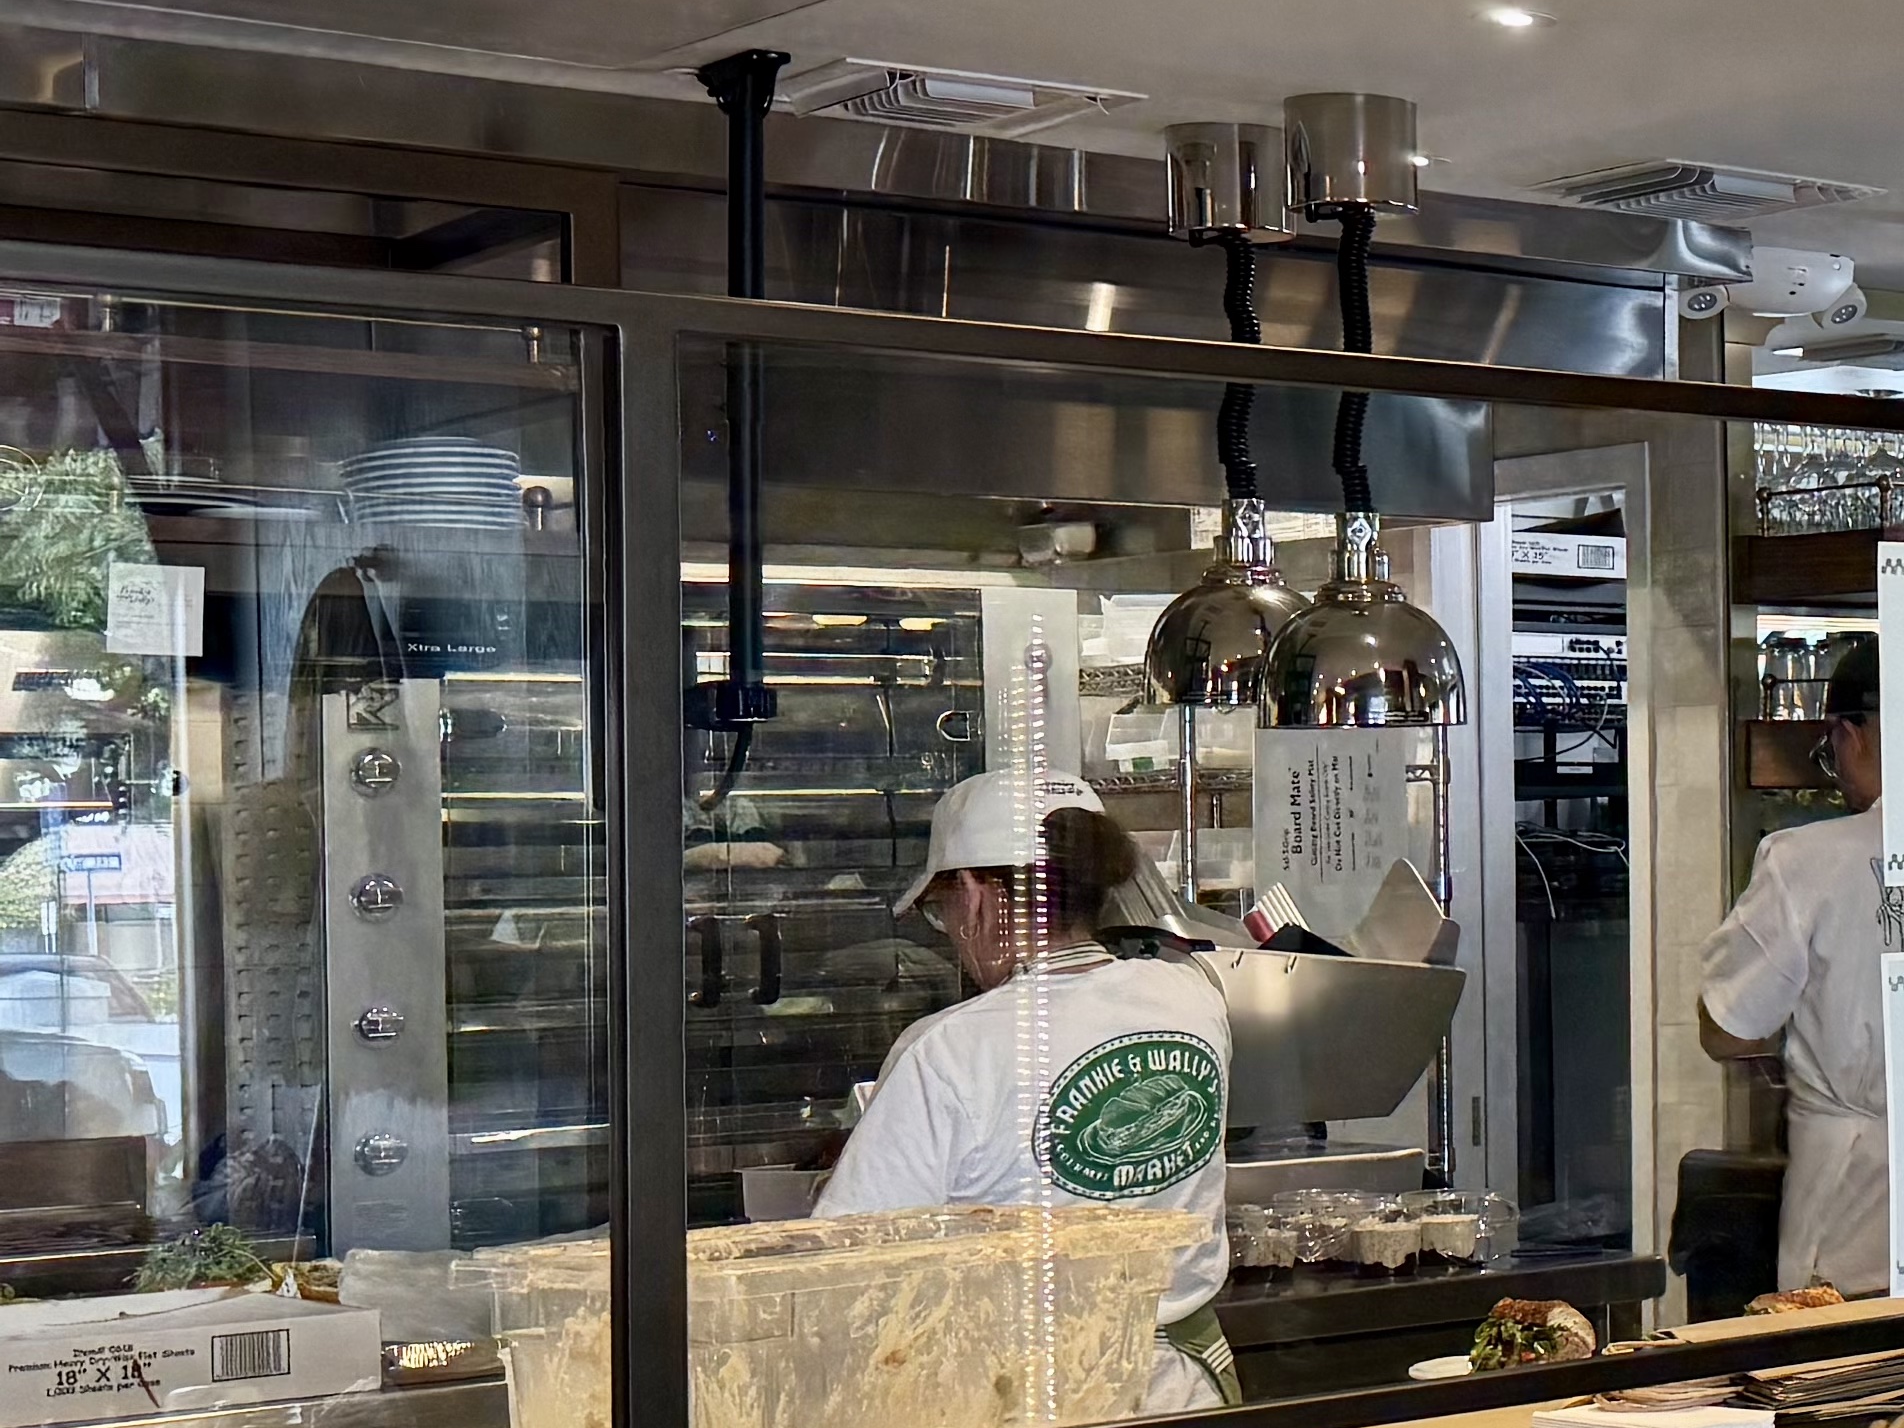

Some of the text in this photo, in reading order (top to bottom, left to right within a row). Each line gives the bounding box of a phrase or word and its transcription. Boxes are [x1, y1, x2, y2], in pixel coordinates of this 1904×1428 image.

[408, 643, 496, 653] Xtra Large
[1290, 770, 1303, 854] Board Mate
[1051, 1049, 1220, 1134] FRANKIE & WALLY'S
[1112, 1140, 1194, 1187] MARKET
[56, 1368, 87, 1387] 18"
[96, 1368, 112, 1384] X
